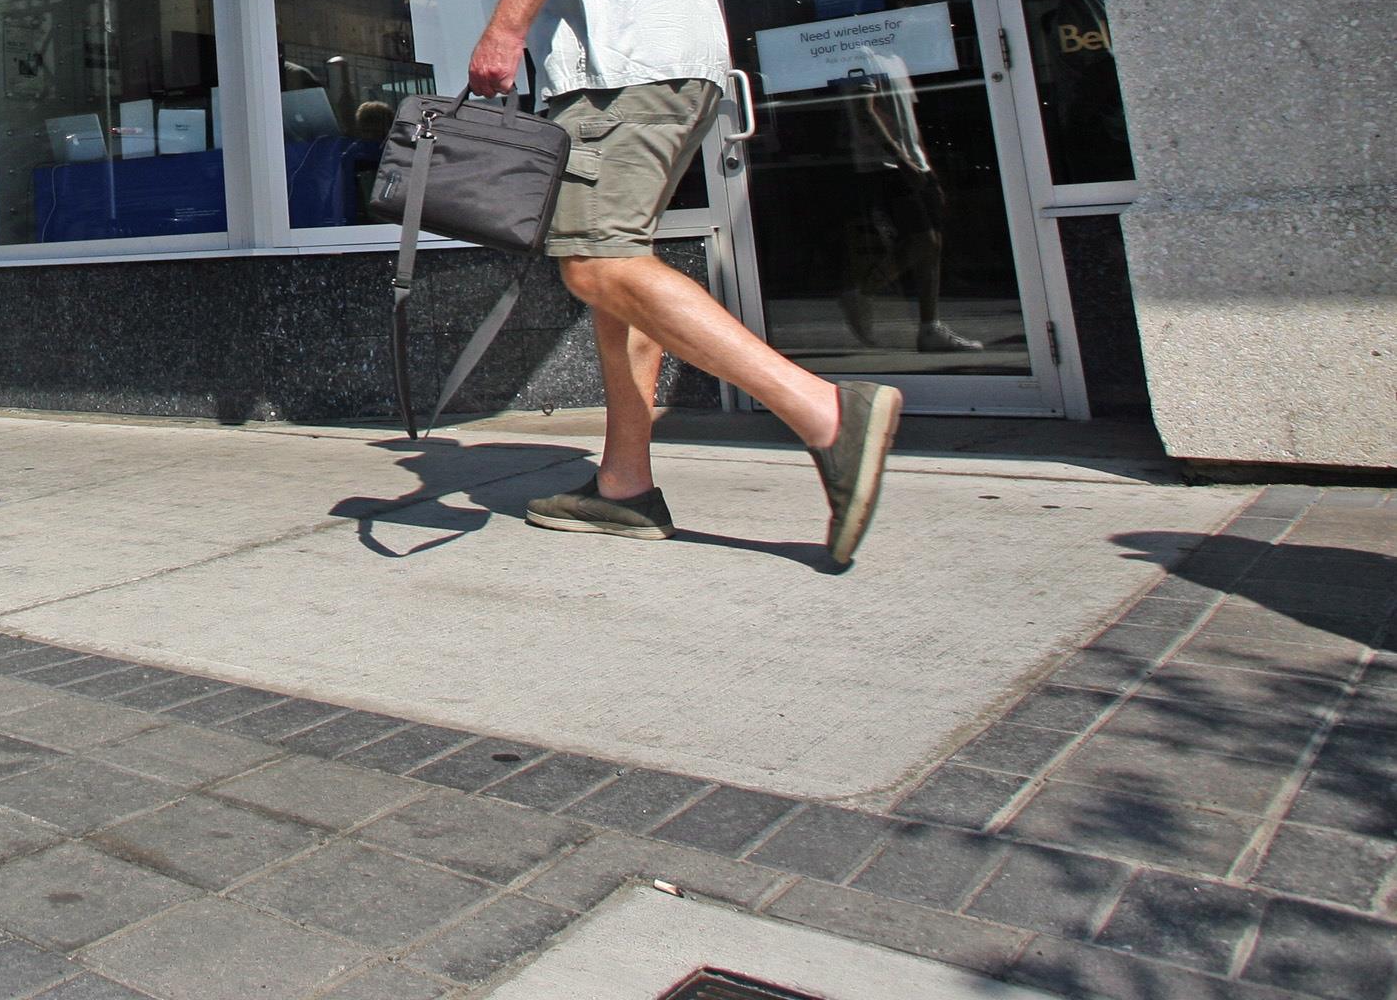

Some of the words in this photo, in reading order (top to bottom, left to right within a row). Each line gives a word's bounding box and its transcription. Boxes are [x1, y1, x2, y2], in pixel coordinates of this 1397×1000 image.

[800, 29, 830, 42] Need
[833, 23, 882, 38] wireless
[884, 19, 902, 30] for
[810, 44, 837, 57] your
[840, 33, 896, 51] business?
